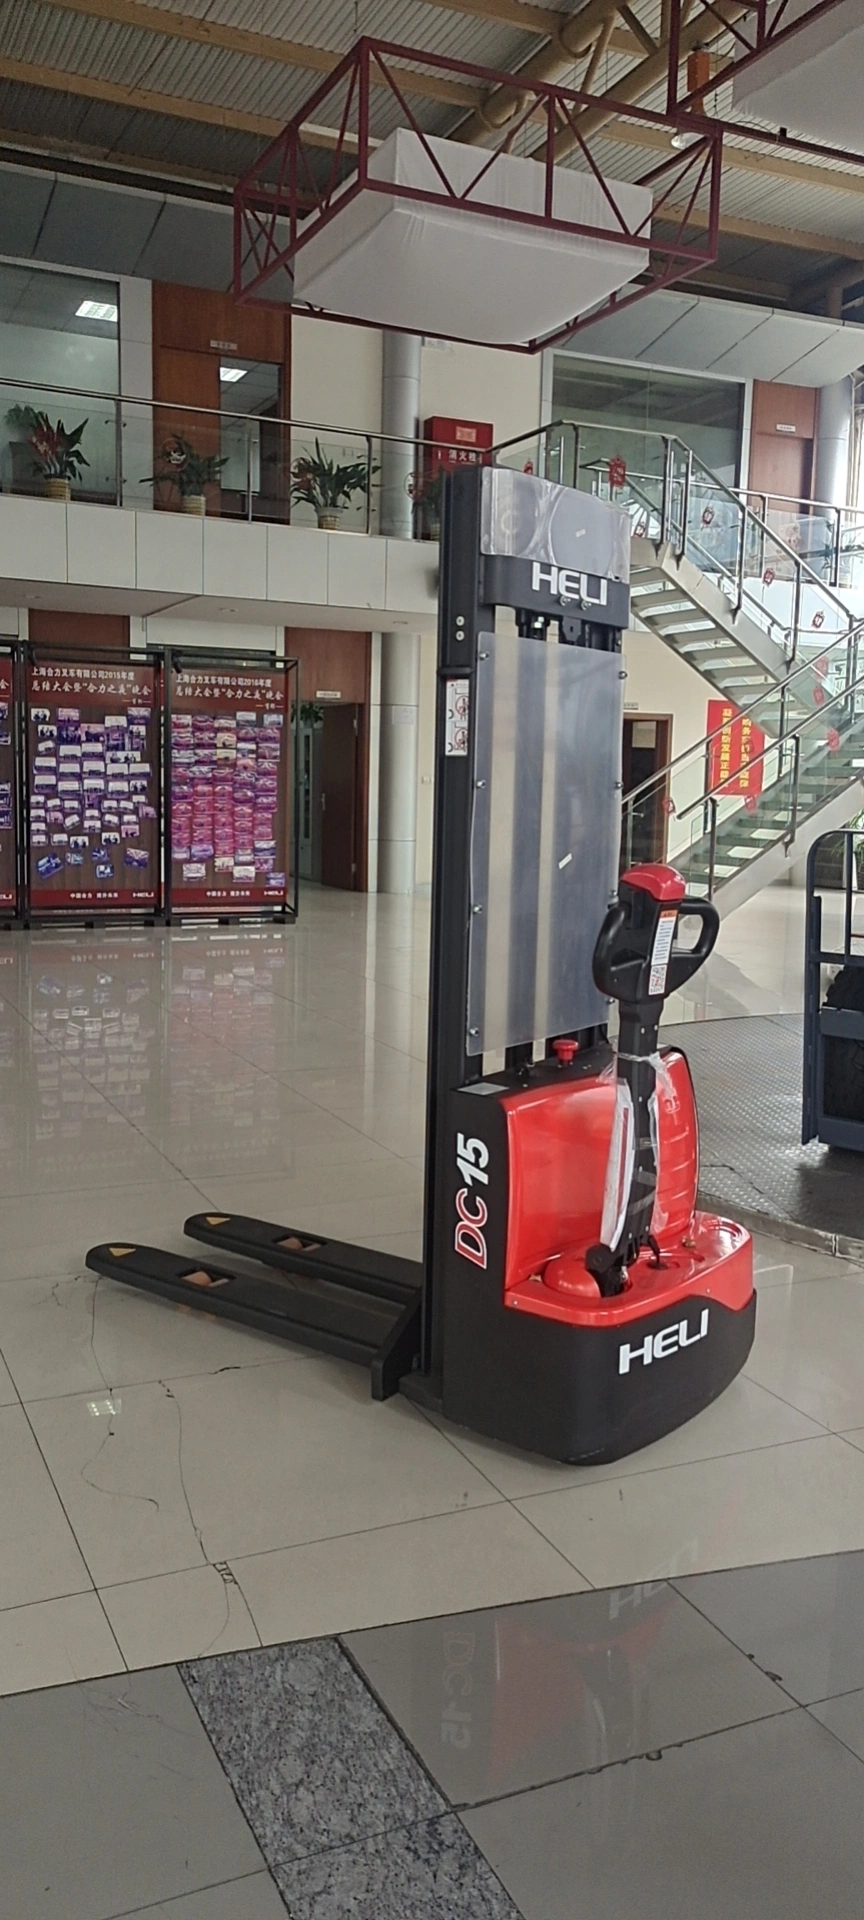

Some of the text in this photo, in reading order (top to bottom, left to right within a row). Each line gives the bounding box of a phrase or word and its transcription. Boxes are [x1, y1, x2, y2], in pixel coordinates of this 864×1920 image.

[448, 449, 477, 462] 消火栓
[532, 561, 607, 606] HELI
[618, 1308, 709, 1375] HELI
